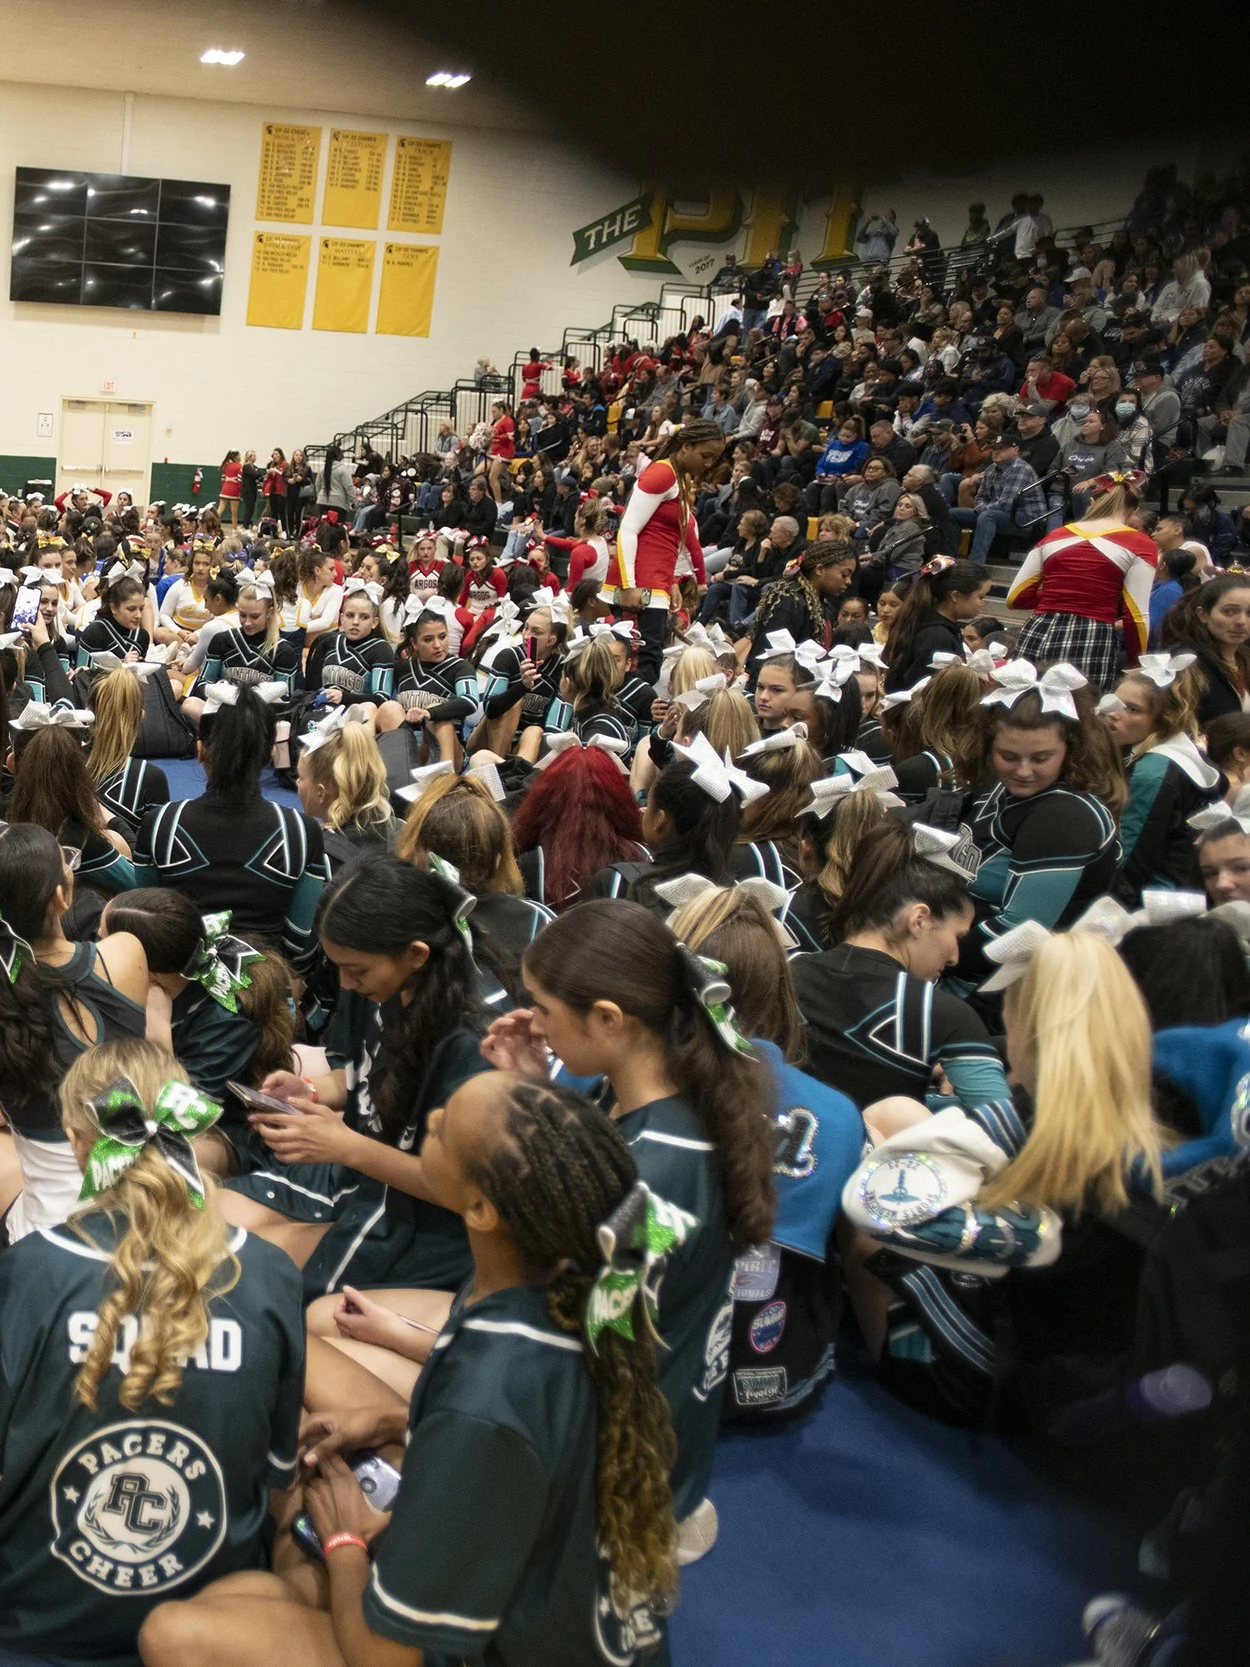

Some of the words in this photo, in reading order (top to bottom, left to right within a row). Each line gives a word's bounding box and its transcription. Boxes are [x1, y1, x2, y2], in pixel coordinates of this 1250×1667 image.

[584, 204, 641, 250] THE
[696, 258, 715, 274] 2017
[103, 381, 115, 390] EXIT
[415, 580, 438, 589] ARGOS
[322, 665, 364, 694] NTIAGO
[865, 1190, 898, 1219] MEDICINE
[903, 1193, 937, 1220] SPORTS
[734, 1259, 776, 1273] PIRIT
[734, 1288, 772, 1298] IONALS
[69, 1312, 241, 1375] SQAD
[78, 1434, 206, 1479] PACERS
[102, 1472, 167, 1535] PC
[70, 1541, 183, 1586] CHEER
